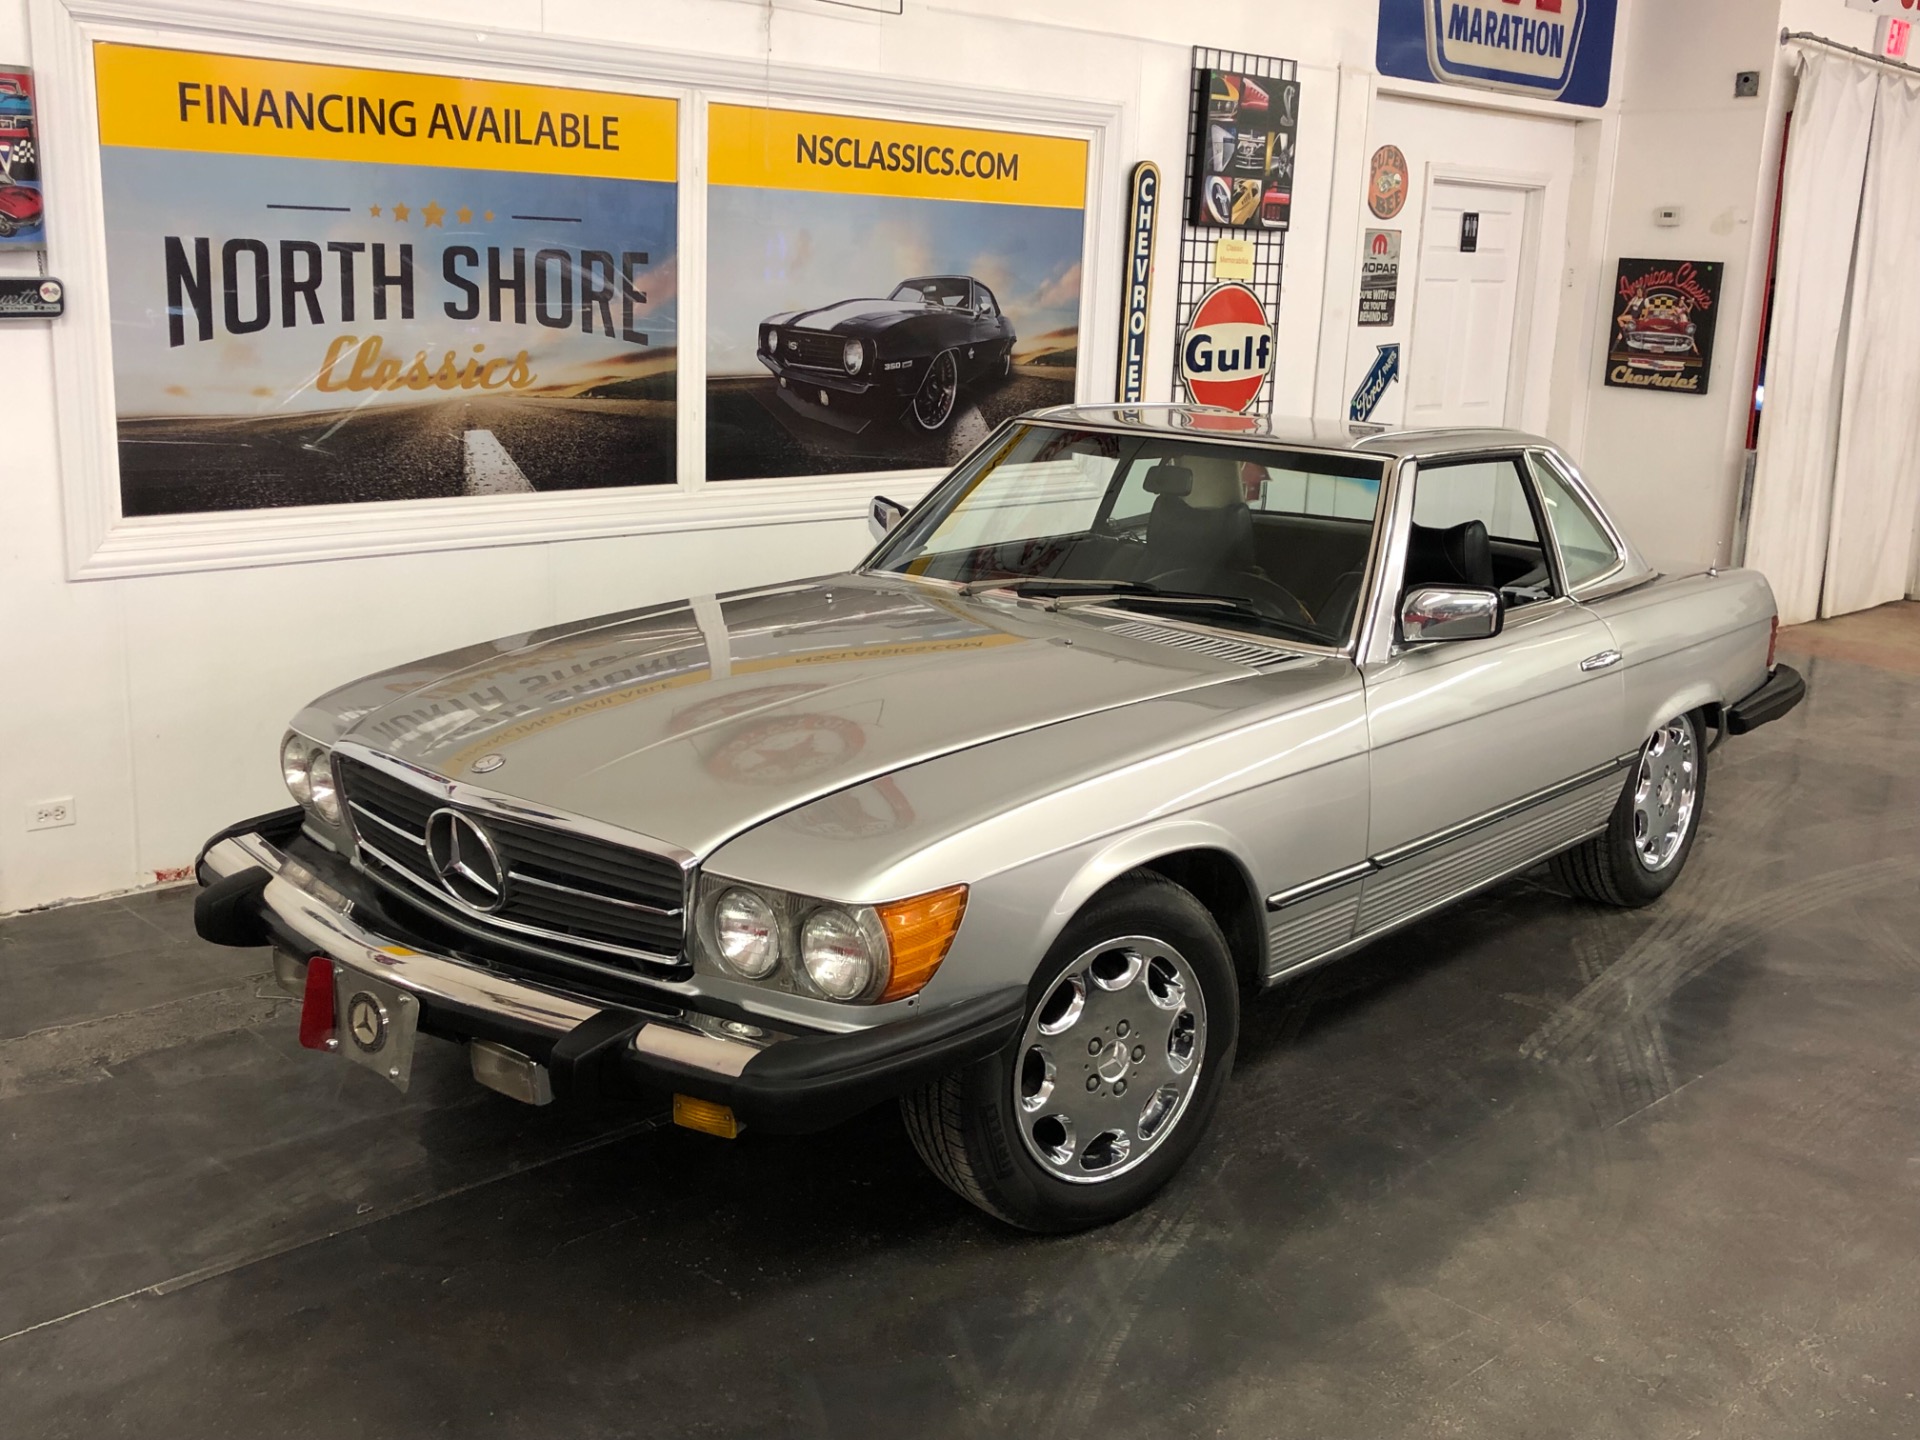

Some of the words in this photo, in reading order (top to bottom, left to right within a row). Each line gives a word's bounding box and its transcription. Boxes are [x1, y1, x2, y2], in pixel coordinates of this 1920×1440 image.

[1448, 3, 1565, 58] MARATHON
[178, 82, 417, 137] FINANCING
[427, 103, 620, 151] AVAILABLE
[796, 133, 1019, 181] NSCLASSICS.COM
[1371, 148, 1406, 183] SUPER
[1375, 190, 1402, 215] BEE
[164, 236, 415, 348] NORTH
[442, 245, 649, 346] SHORE
[1359, 291, 1373, 300] OU'RE
[1373, 289, 1389, 300] WITH
[1388, 291, 1396, 300] US
[1619, 267, 1675, 300] American
[1359, 311, 1381, 322] BEHIND
[1381, 312, 1388, 321] US
[1362, 302, 1370, 310] OR
[315, 335, 537, 392] Classics
[1185, 334, 1270, 373] Gulf
[1356, 369, 1385, 422] Ford
[1381, 350, 1397, 375] PARTS
[1611, 365, 1698, 389] Chevrolet
